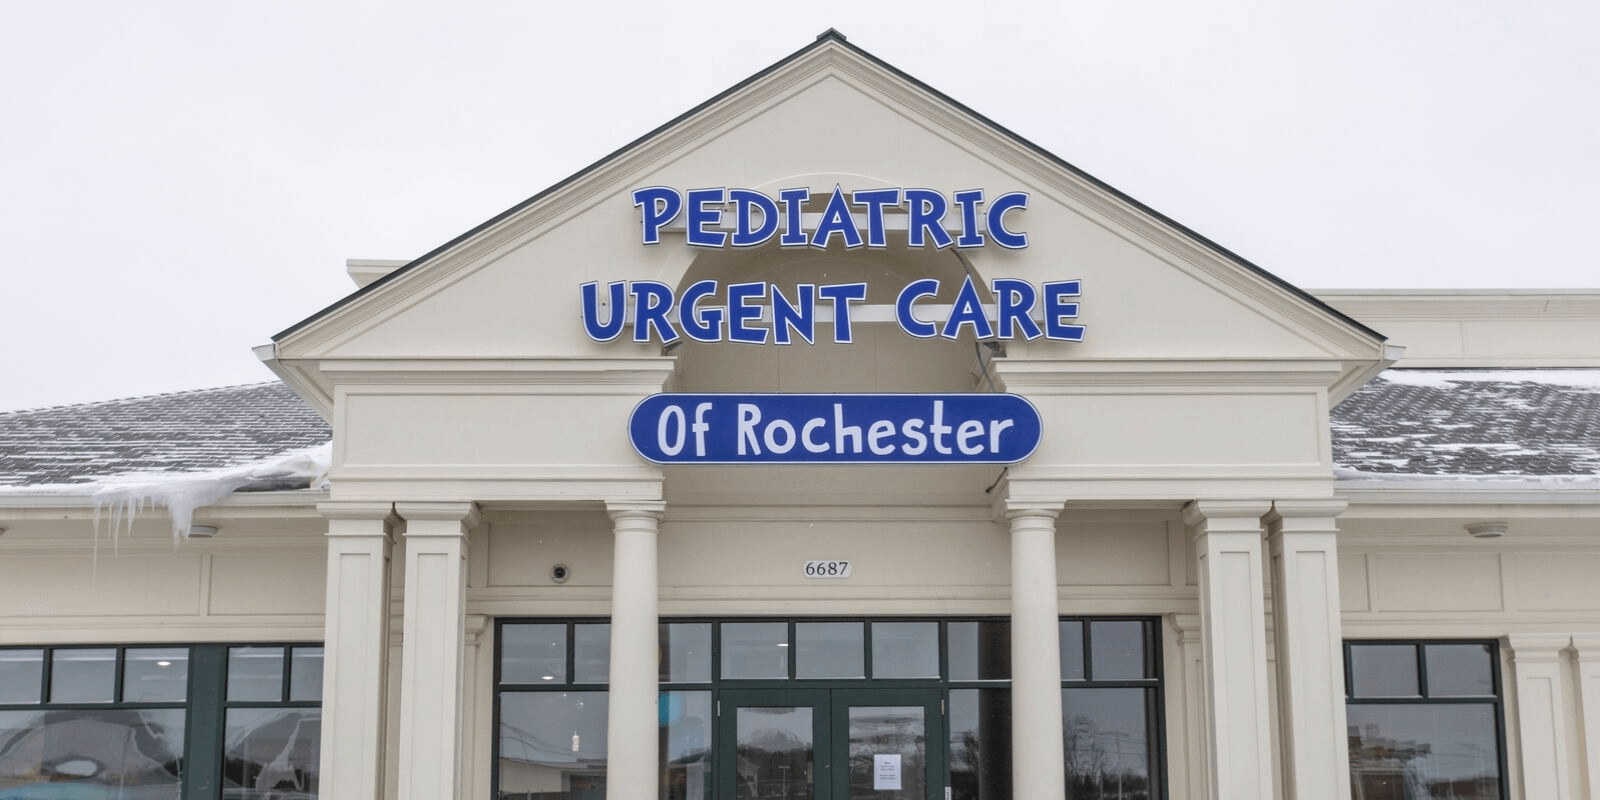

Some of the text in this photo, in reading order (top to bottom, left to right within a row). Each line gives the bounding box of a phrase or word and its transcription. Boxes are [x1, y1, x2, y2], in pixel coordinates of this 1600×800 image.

[632, 184, 1030, 250] PEDIATRIC
[579, 274, 1087, 346] URGENT CARE
[656, 401, 1015, 457] Of Rochester
[806, 561, 848, 576] 6687
